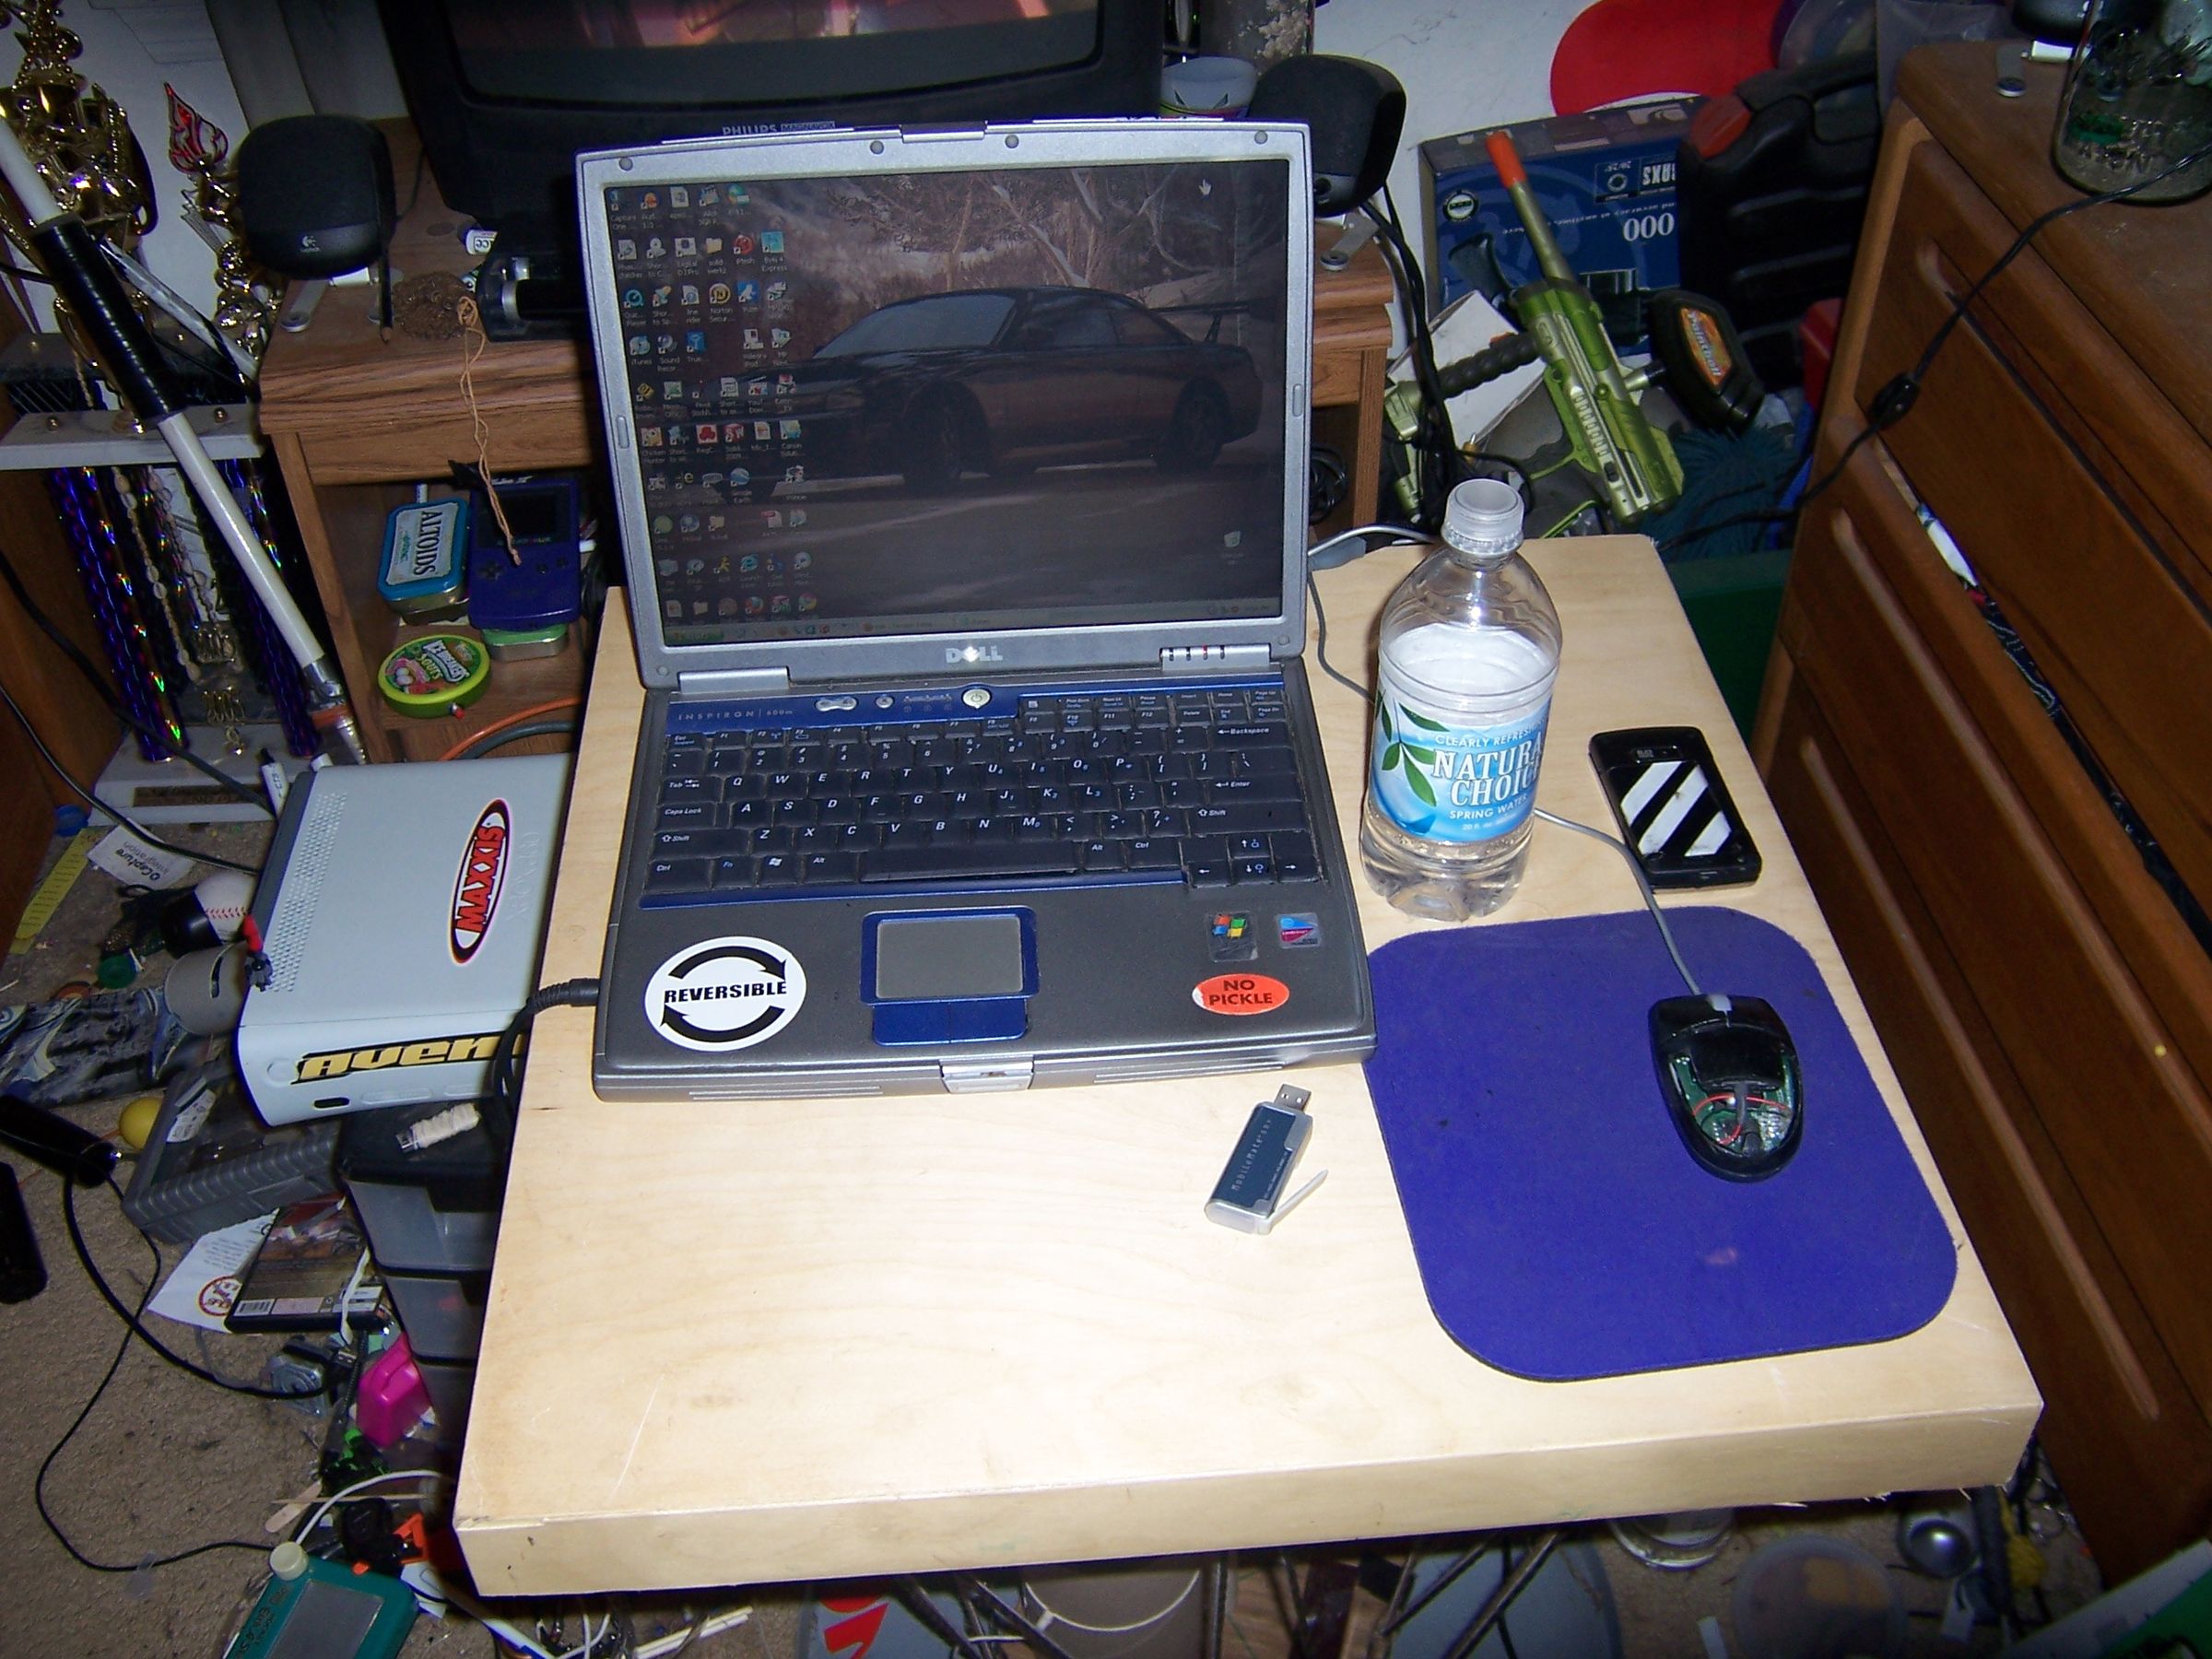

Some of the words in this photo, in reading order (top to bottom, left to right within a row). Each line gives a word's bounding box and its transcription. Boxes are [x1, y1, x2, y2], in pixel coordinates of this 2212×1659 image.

[723, 124, 777, 135] PHILIPS
[415, 511, 443, 576] ALTOIDS
[946, 646, 1003, 664] DLL
[678, 711, 754, 721] INSPIRON
[1230, 727, 1269, 735] Backspace
[1435, 735, 1490, 747] CLEARLY
[1030, 762, 1037, 771] I
[1073, 759, 1082, 769] O
[1115, 758, 1124, 767] P
[903, 769, 912, 777] T
[946, 767, 954, 775] Y
[988, 764, 997, 773] U
[775, 775, 790, 783] W
[818, 773, 828, 782] E
[861, 771, 870, 780] R
[733, 777, 743, 786] Q
[1000, 790, 1010, 799] J
[1043, 788, 1053, 797] K
[1086, 786, 1093, 795] L
[870, 797, 880, 806] F
[913, 794, 924, 804] G
[957, 793, 967, 802] H
[784, 801, 794, 810] S
[828, 799, 838, 808] D
[741, 804, 751, 813] A
[1449, 807, 1494, 819] SPRING
[935, 822, 946, 830] B
[979, 819, 990, 829] N
[1022, 818, 1036, 827] M
[804, 828, 815, 837] X
[847, 826, 856, 835] C
[891, 823, 900, 833] V
[759, 830, 771, 839] Z
[456, 827, 506, 934] MAXXIS
[1223, 979, 1256, 992] NO
[664, 982, 787, 1004] REVERSIBLE
[1208, 992, 1273, 1006] PICKLE
